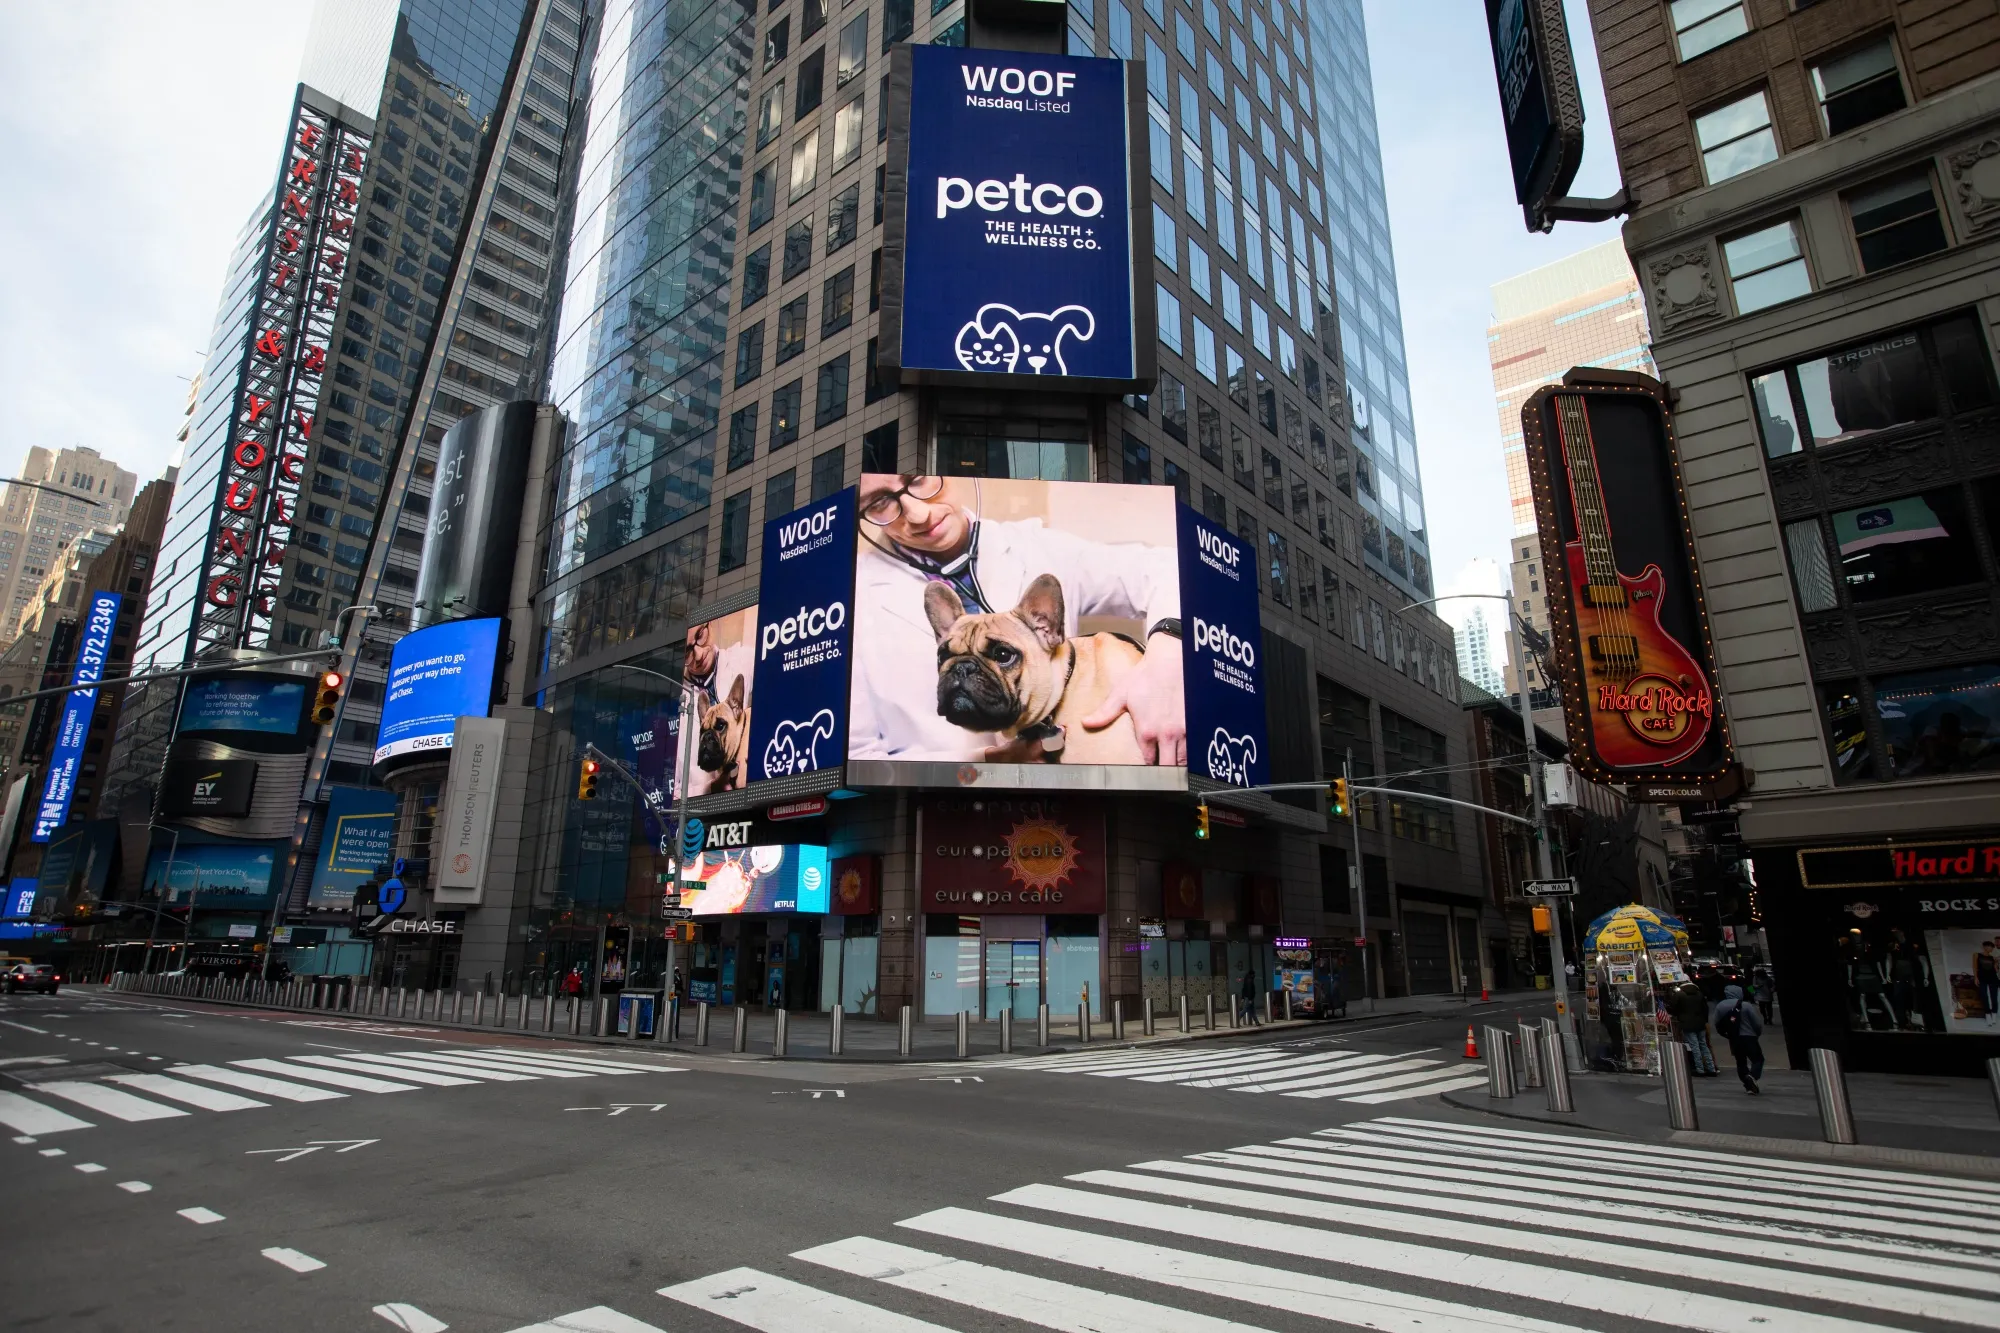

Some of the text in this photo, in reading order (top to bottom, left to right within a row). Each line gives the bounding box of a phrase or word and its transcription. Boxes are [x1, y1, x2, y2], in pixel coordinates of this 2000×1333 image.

[1503, 26, 1529, 101] TACO
[961, 64, 1076, 97] WOOF
[1509, 59, 1535, 126] BELL
[966, 94, 1070, 114] Nasdaq Listed
[937, 173, 1104, 219] petco
[985, 220, 1015, 232] THE
[1021, 222, 1081, 236] HEALTH
[985, 233, 1102, 250] WELLNESS CO.
[207, 124, 321, 608] ERNST & YOUNG
[779, 505, 838, 549] WOOF
[780, 532, 833, 562] Nasdaq Listed
[1196, 525, 1240, 567] WOOF
[1200, 552, 1240, 582] Nasdaq Listed
[761, 601, 845, 661] petco
[1193, 616, 1254, 667] petco
[75, 598, 116, 697] 212.372.2349
[783, 646, 799, 660] THE
[800, 639, 832, 657] HEALTH
[413, 660, 424, 672] you
[425, 655, 443, 666] want
[444, 654, 452, 663] to
[453, 653, 466, 663] go,
[782, 648, 842, 672] WELLNESS CO.
[1213, 659, 1226, 671] THE
[1226, 661, 1249, 682] HEALTH
[410, 672, 425, 684] your
[425, 669, 439, 680] way
[440, 666, 461, 676] there
[1214, 670, 1256, 694] WELLNESS CO.
[229, 693, 261, 701] together
[1598, 685, 1712, 718] Hard Rock
[225, 708, 241, 716] New
[242, 709, 259, 717] York
[1643, 718, 1676, 731] CAFE
[61, 709, 78, 747] FOR INQUIRIES
[72, 723, 85, 748] CONTACT
[412, 737, 443, 749] CHASE
[46, 767, 62, 800] Newmark
[56, 758, 76, 801] Knight Frank
[194, 783, 217, 796] EY
[460, 743, 484, 847] THOMSON REUTERS
[1648, 788, 1702, 796] SPECTACOLOR
[341, 838, 389, 849] were open
[344, 826, 390, 839] What if all
[706, 821, 753, 848] AT&T
[1892, 848, 1976, 878] Hard
[1530, 883, 1567, 892] ONE WAY
[774, 900, 796, 909] NETFLIX
[1919, 898, 1982, 912] ROCK
[391, 919, 456, 933] CHASE
[1599, 941, 1642, 950] SABRETT
